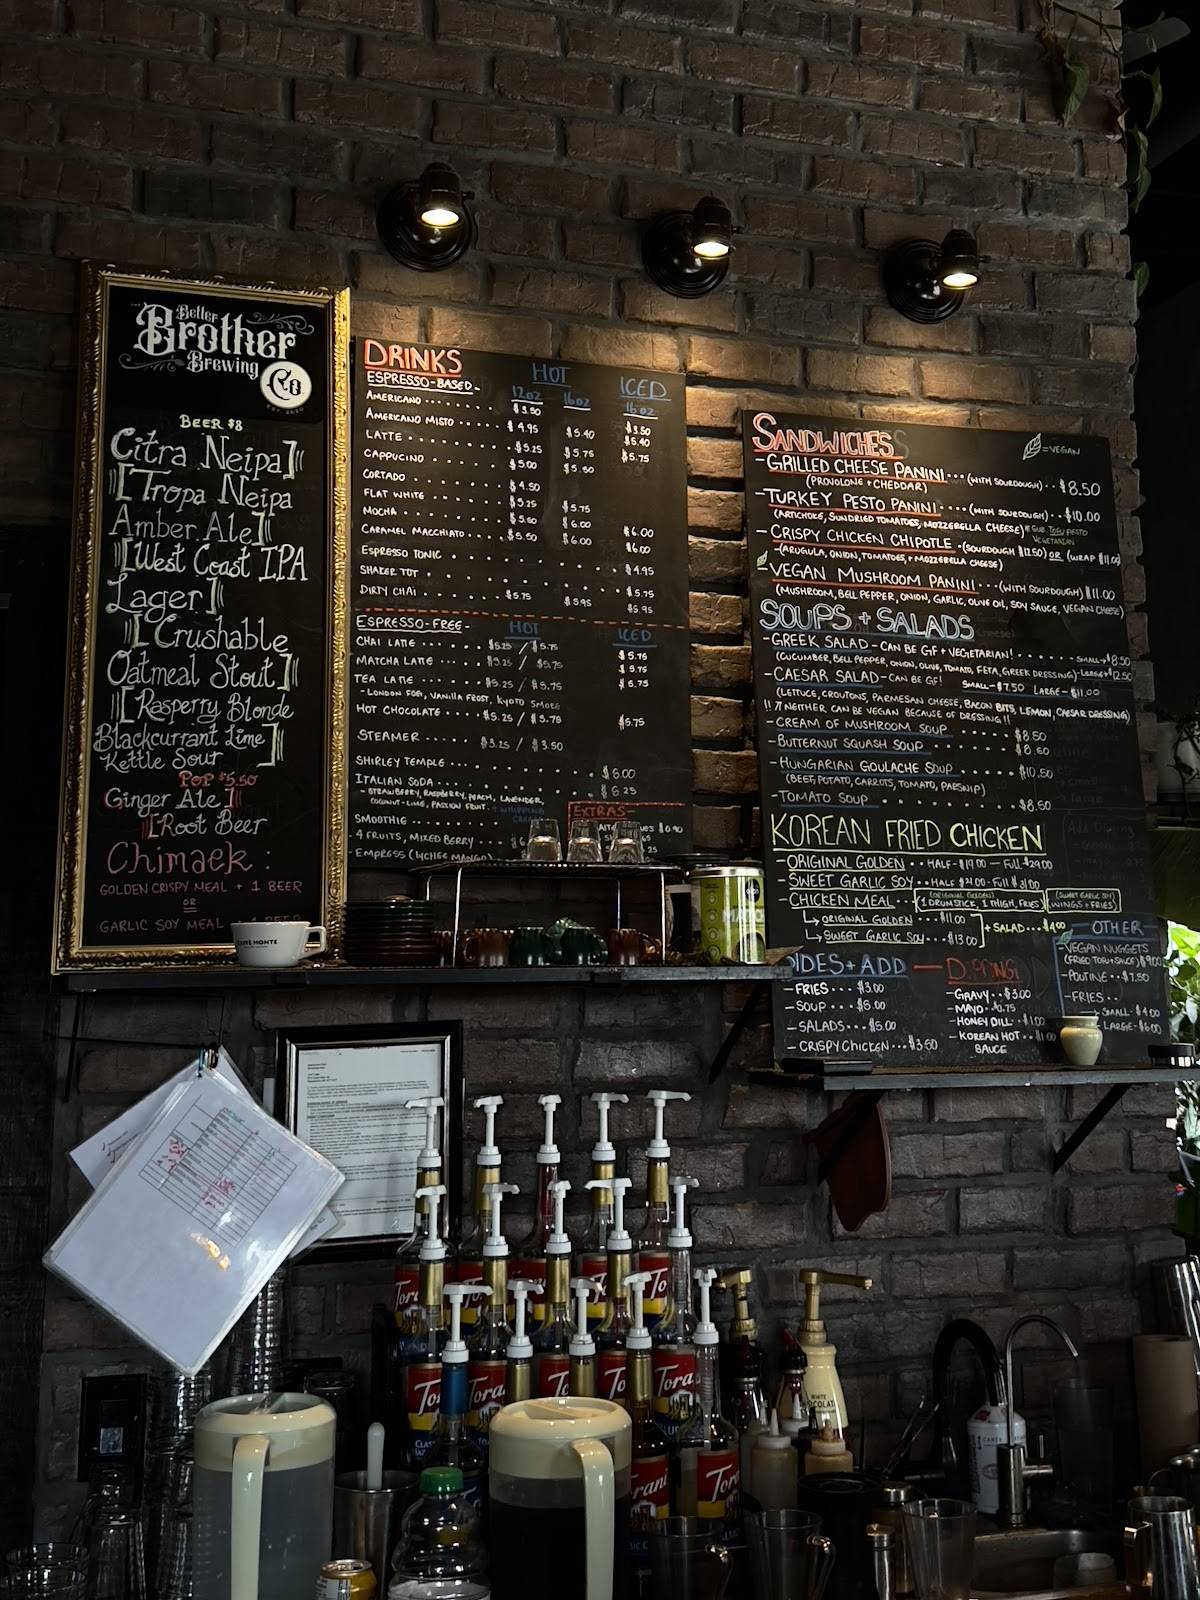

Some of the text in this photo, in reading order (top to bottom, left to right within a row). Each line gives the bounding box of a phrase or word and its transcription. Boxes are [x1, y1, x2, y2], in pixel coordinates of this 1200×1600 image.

[176, 303, 219, 321] Better
[132, 302, 297, 359] Brother
[186, 351, 259, 380] Brewing
[364, 339, 463, 374] DRINKS
[532, 362, 571, 383] HOT
[267, 368, 301, 400] Co
[620, 376, 667, 397] ICED
[513, 403, 541, 416] $3.50
[227, 419, 243, 431] $8
[426, 416, 454, 426] MISTO
[366, 430, 402, 440] LATTE
[752, 412, 895, 458] SANDWICHES
[110, 427, 281, 480] Citra Neipa
[364, 449, 537, 471] CAPPUCINO $5.00
[363, 469, 406, 482] CORTADO
[767, 454, 1101, 496] GRILLED CHEESE PANINI $8.50
[129, 469, 293, 517] Tropa Neipa
[364, 489, 425, 500] FLAT WHITE
[763, 488, 1100, 523] TURKEY PESTO PANINI $10.00
[109, 503, 198, 540] Amber
[363, 506, 654, 538] MOCHA $6.00
[362, 524, 592, 546] CARAMEL MACCHIATO $6.00
[770, 524, 952, 549] CRISPY CHICKEN CHIPOTLE
[362, 545, 441, 559] ESPRESSO TONIC
[134, 543, 308, 582] West Coast IPA
[769, 562, 1115, 600] VEGAN MUSHROOM PANINI $11.00
[105, 574, 204, 623] Lager
[360, 585, 388, 596] DIRTY
[760, 598, 975, 640] SOUPS SALADS
[154, 613, 289, 652] Crushable
[509, 621, 652, 641] HOT ICED
[356, 636, 385, 647] CHAI
[772, 633, 916, 653] GREEK SALAD CAN BE
[106, 649, 276, 689] Oatmeal Stout
[356, 656, 399, 665] MATCHA
[354, 674, 379, 684] TEA
[774, 667, 879, 683] CAESAR SALAD
[227, 694, 294, 720] Blonde
[356, 705, 441, 717] HOT CHOCOLATE
[93, 723, 266, 752] Blackcurrant Lime
[357, 730, 419, 741] STEAMER
[775, 716, 1047, 741] CREAM OF MUSHROOM SOUP $8.50
[778, 734, 924, 751] BUTTERNUT SQUASH SOUP
[101, 750, 223, 773] Kettle Sour
[356, 757, 636, 780] SHIRLEY TEMPLE $6.00
[780, 756, 1053, 780] HUNGARIAN GOULACHE SOUP $10.50
[355, 774, 433, 787] ITALIAN SODA
[101, 786, 172, 818] Ginger
[778, 790, 1051, 813] TOMATO SOUP $8.50
[574, 806, 626, 818] EXTRAS
[160, 809, 267, 837] Root Beer
[771, 812, 1043, 850] KOREAN FRIED CHICKEN
[787, 855, 905, 870] ORIGINAL GOLDEN
[100, 880, 302, 896] GOLDEN CRISPY MEAL BEER
[789, 874, 914, 889] SWEET GARLIC SOY
[789, 893, 894, 908] CHICKEN MEAL
[101, 920, 147, 933] GARLIC
[155, 920, 179, 931] SOY
[187, 919, 224, 930] MEAL
[822, 914, 914, 924] ORIGINAL GOLDEN
[1092, 920, 1145, 935] OTHER
[824, 929, 925, 944] SWEET GARLIC SOY
[994, 924, 1025, 933] SALAD
[1066, 943, 1149, 953] VEGAN NUGGETS
[861, 953, 907, 975] ADD
[1069, 972, 1107, 982] POUTINE
[795, 980, 884, 995] FRIES $3.00
[954, 988, 1031, 1001] GRAVY $3.00
[1072, 991, 1103, 1003] FRIES
[796, 1001, 826, 1013] SOUP
[955, 1005, 984, 1014] MAYO
[799, 1017, 897, 1033] SALADS $5.00
[957, 1016, 1013, 1026] HONEY DILL
[958, 1031, 1020, 1040] KOREAN HOT
[800, 1041, 840, 1052] CRISPY
[974, 1044, 1007, 1054] SAUCE
[655, 1364, 693, 1397] Tora
[467, 1376, 506, 1409] Tora
[631, 1467, 669, 1500] rani
